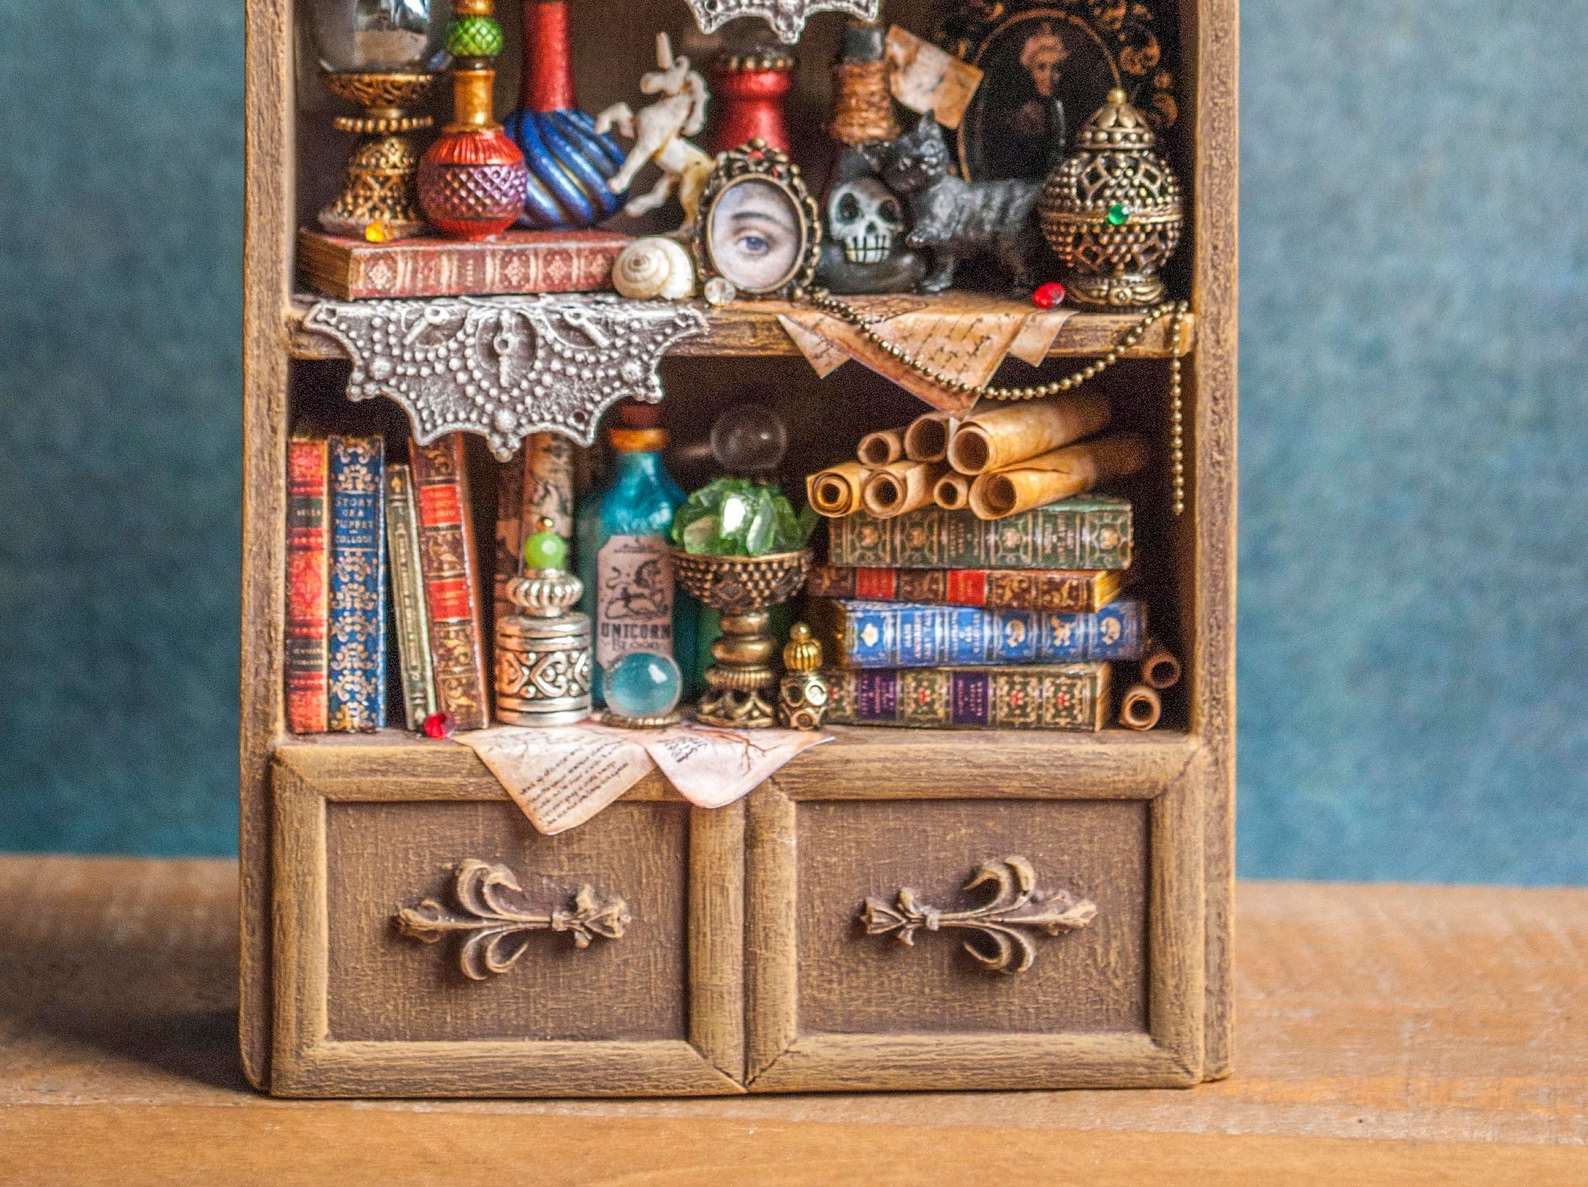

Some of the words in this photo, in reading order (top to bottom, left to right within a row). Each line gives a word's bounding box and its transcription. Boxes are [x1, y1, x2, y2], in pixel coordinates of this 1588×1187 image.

[336, 497, 373, 506] STORY
[356, 509, 364, 517] A
[336, 519, 373, 528] PUPPET
[601, 623, 671, 639] UNICORN
